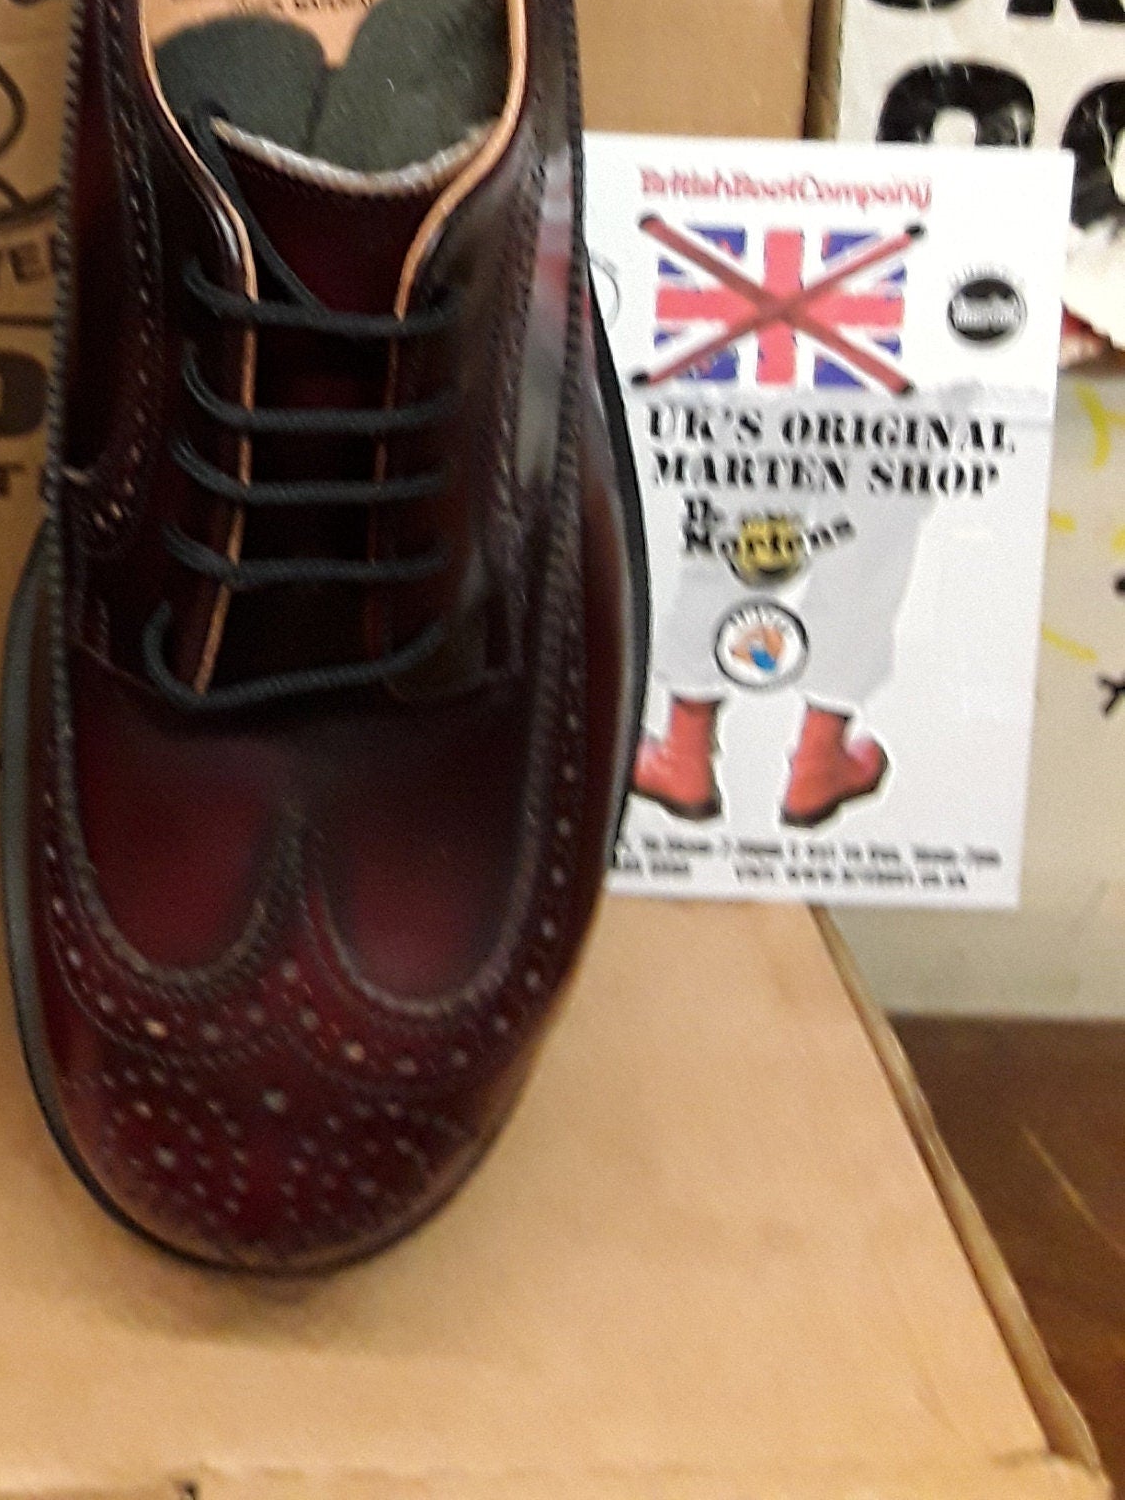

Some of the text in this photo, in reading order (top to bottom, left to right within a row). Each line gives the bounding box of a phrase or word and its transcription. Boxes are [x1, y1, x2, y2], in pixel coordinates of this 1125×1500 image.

[648, 404, 1017, 453] UK'S ORIGINAL
[654, 452, 999, 499] MARTEN SHOP
